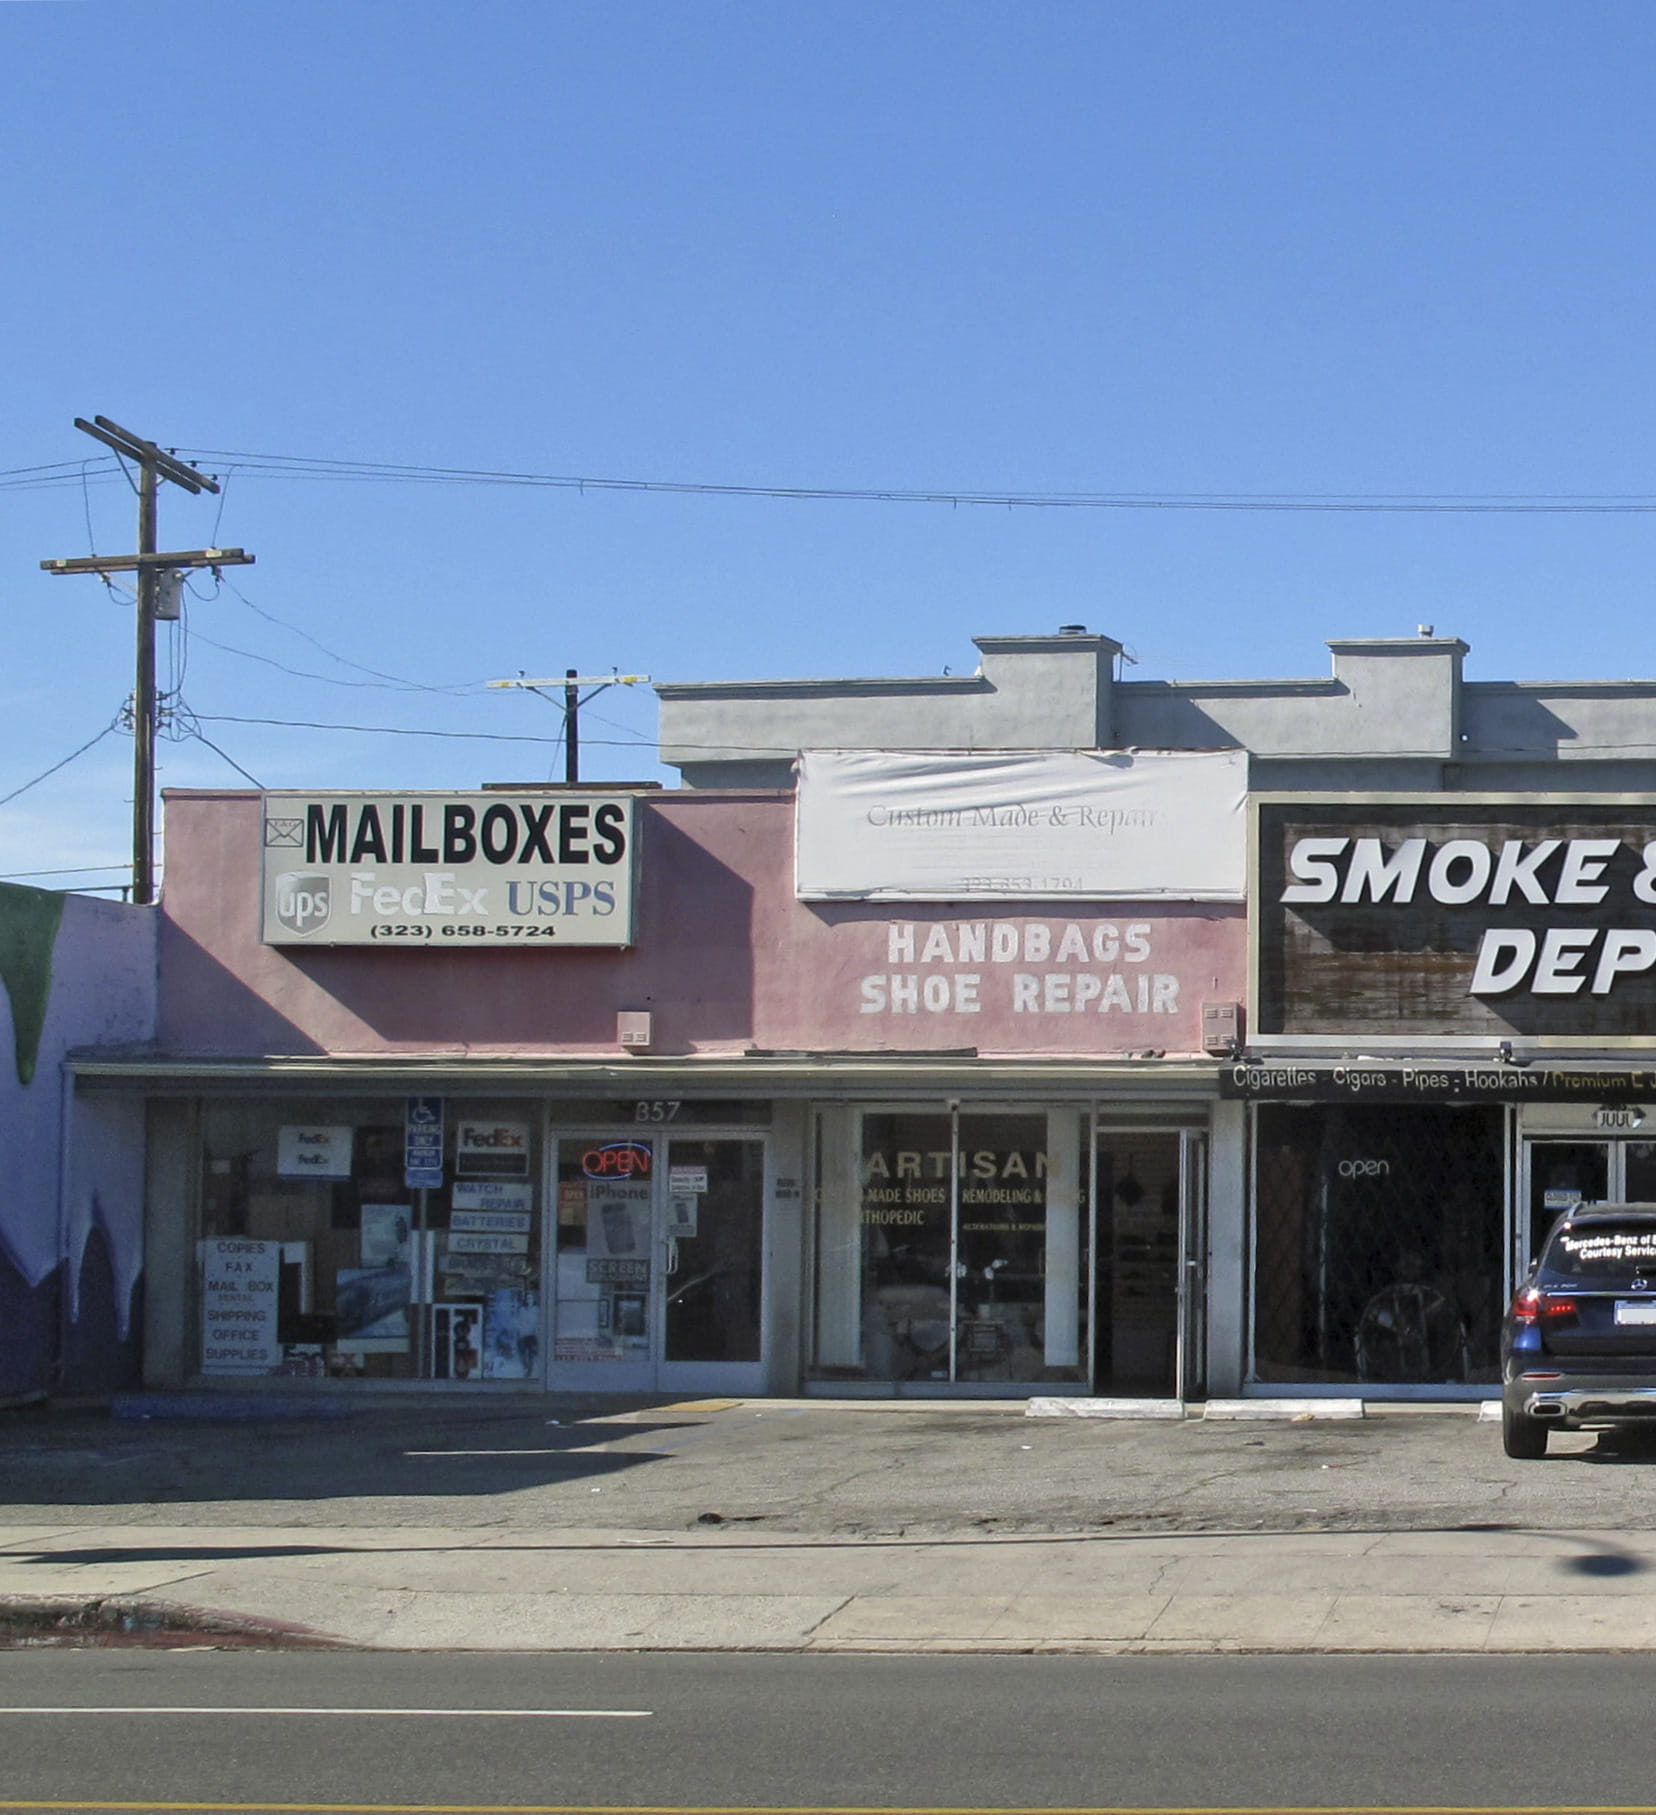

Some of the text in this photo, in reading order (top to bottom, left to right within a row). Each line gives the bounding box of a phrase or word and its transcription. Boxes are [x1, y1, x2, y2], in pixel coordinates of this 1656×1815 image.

[866, 804, 962, 828] Custom
[972, 803, 1039, 827] Made
[1048, 806, 1069, 827] &
[305, 804, 626, 864] MAILBOXES
[1279, 837, 1624, 906] SMOKE
[278, 872, 616, 927] ups FedEx USPS
[370, 924, 556, 939] (323) 658-5724
[887, 923, 1152, 964] HANDBAGS
[860, 974, 1180, 1014] SHOE REPAIR
[1233, 1065, 1316, 1090] Cigarettes
[1333, 1067, 1387, 1092] Cigars
[1402, 1067, 1449, 1091] Pipes
[1465, 1069, 1538, 1089] Hookahs
[1552, 1070, 1626, 1089] Premium
[635, 1102, 681, 1121] 357
[1600, 1112, 1631, 1128] JUUL
[463, 1128, 523, 1148] FedEx
[583, 1151, 650, 1173] OPEN
[1338, 1159, 1390, 1180] open
[456, 1184, 503, 1195] WATCH
[590, 1183, 649, 1200] iPhone
[868, 1188, 902, 1204] MADE
[905, 1188, 946, 1204] SHOES
[962, 1188, 1033, 1204] REMODELING
[452, 1214, 525, 1228] BATTERIES
[859, 1209, 926, 1225] THOPEDIC
[217, 1242, 266, 1254] COPIES
[456, 1238, 516, 1250] CRYSTAL
[1565, 1234, 1638, 1251] Mercedes-Benz
[1640, 1234, 1651, 1246] of
[1580, 1246, 1623, 1260] Courtesy
[225, 1262, 253, 1273] FAX
[588, 1261, 647, 1274] SCREEN
[207, 1281, 274, 1292] MAIL BOX
[207, 1310, 267, 1321] SHIPPING
[213, 1329, 260, 1341] OFFICE
[206, 1348, 269, 1361] SUPPLIES
